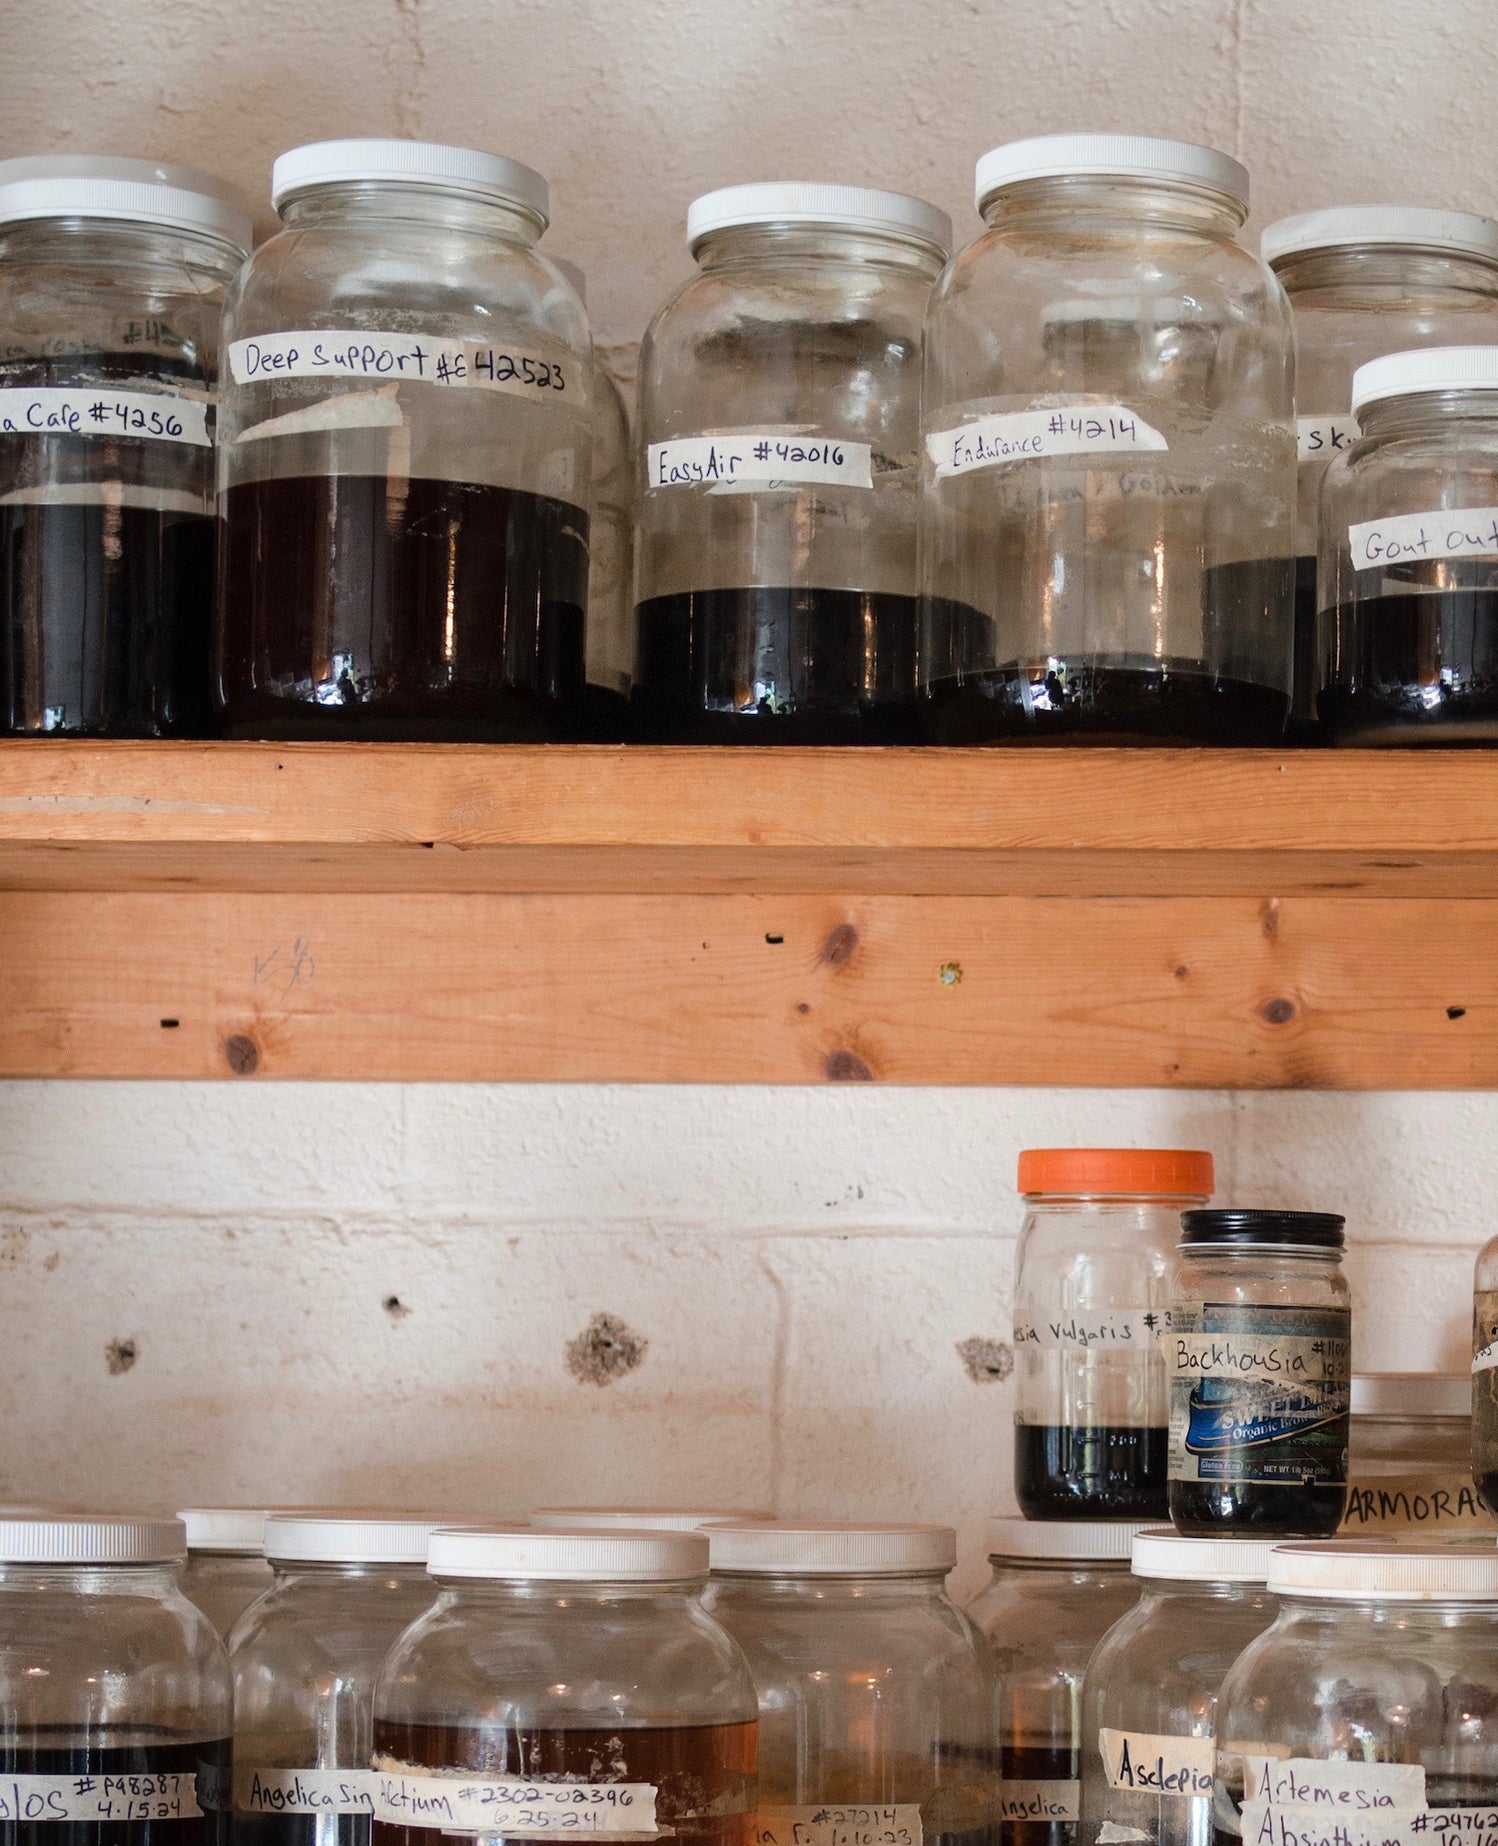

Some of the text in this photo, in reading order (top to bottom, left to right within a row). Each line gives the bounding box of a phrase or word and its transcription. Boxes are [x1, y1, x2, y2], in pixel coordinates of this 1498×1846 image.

[246, 343, 299, 375] Deep
[311, 344, 430, 377] Support
[88, 401, 183, 436] #4256
[753, 441, 844, 466] #42016
[951, 413, 1137, 468] Endurance #4214
[1365, 531, 1430, 563] Gout
[1049, 1316, 1132, 1347] Vulgaris
[1176, 1340, 1308, 1373] Backhousia
[1232, 1421, 1278, 1441] Organic
[250, 1773, 334, 1811] Angelica
[1258, 1761, 1395, 1808] Artemesia
